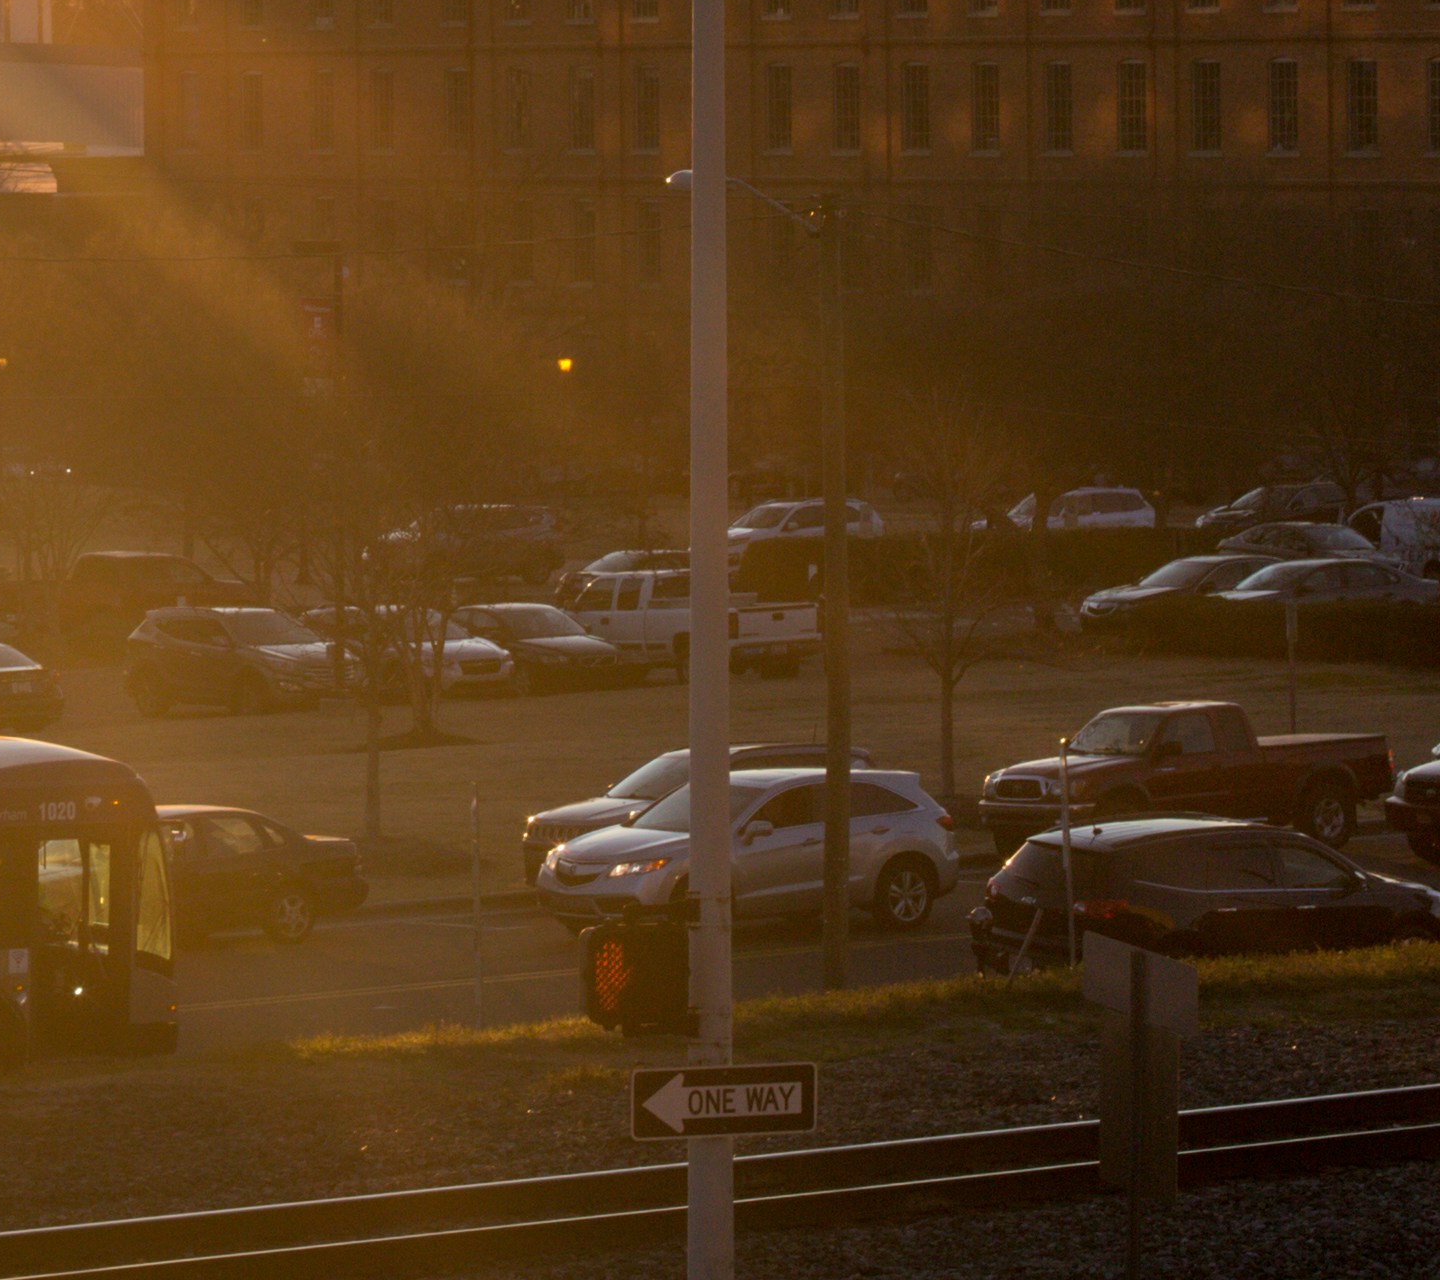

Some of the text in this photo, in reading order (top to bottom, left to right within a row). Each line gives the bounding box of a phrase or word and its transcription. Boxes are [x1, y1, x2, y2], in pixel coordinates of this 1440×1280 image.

[38, 801, 76, 822] 1020
[688, 1085, 795, 1115] ONE WAY
